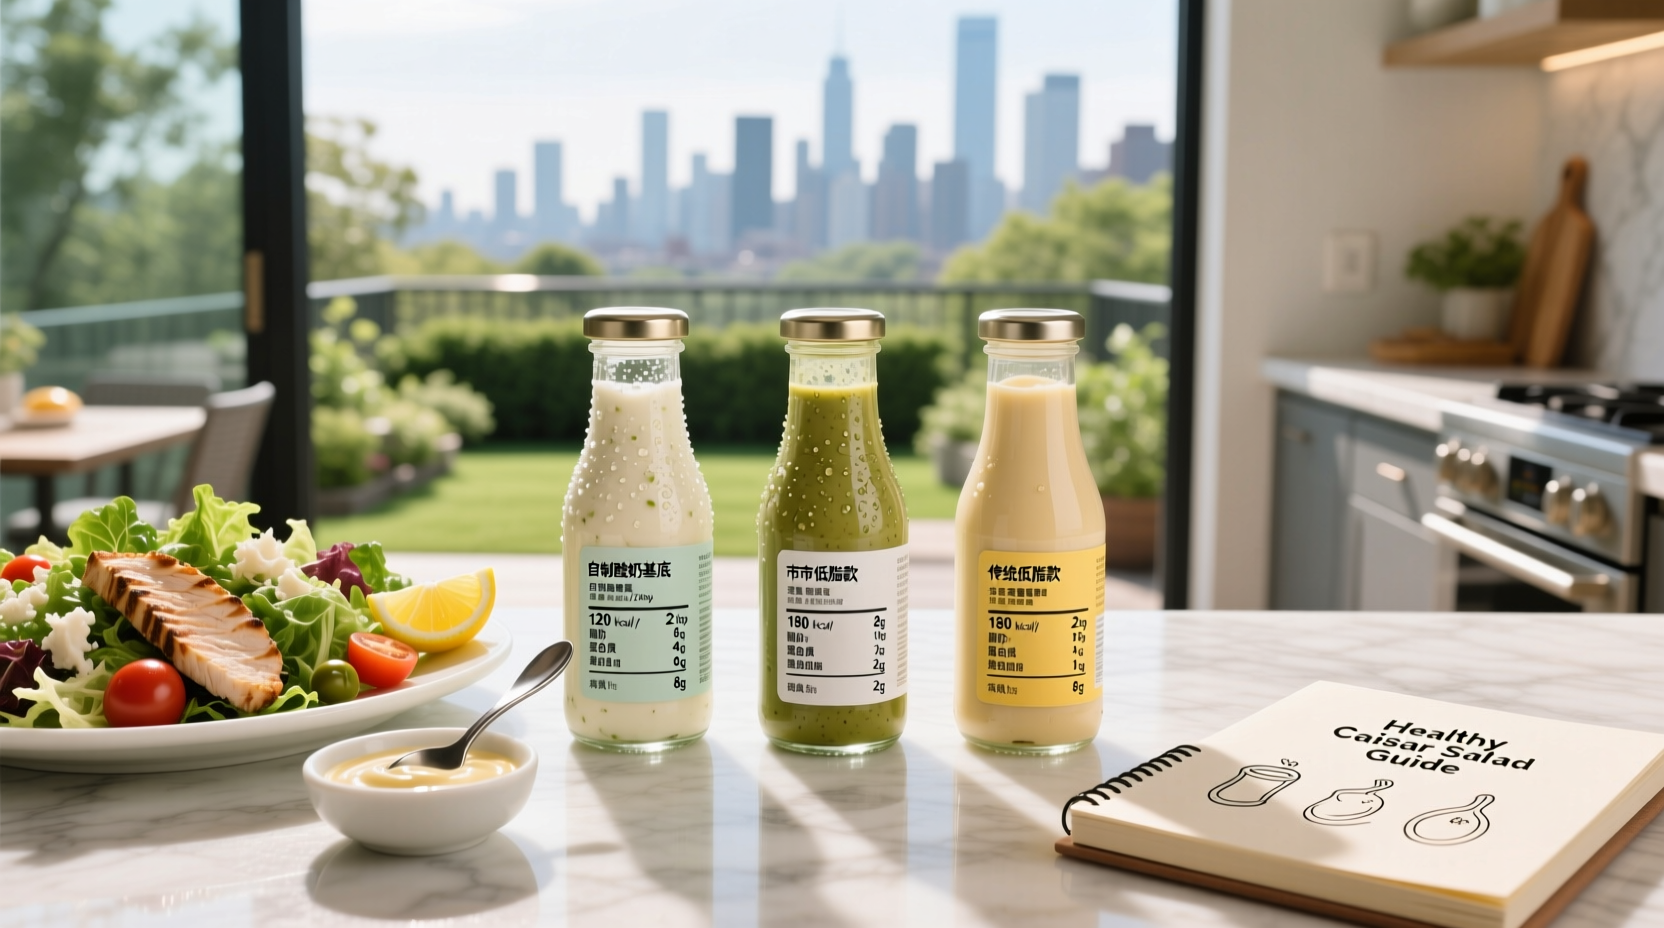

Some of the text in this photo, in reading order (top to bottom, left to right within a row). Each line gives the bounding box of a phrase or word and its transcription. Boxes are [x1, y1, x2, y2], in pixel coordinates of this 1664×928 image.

[589, 613, 611, 626] 120
[788, 615, 809, 629] 180
[873, 615, 886, 630] 2g
[989, 616, 1012, 629] 180
[673, 676, 686, 691] 8g
[873, 680, 885, 694] 2g
[1383, 719, 1508, 751] Healthy
[1333, 726, 1535, 770] Caisar Salad
[1366, 749, 1460, 774] Guide
